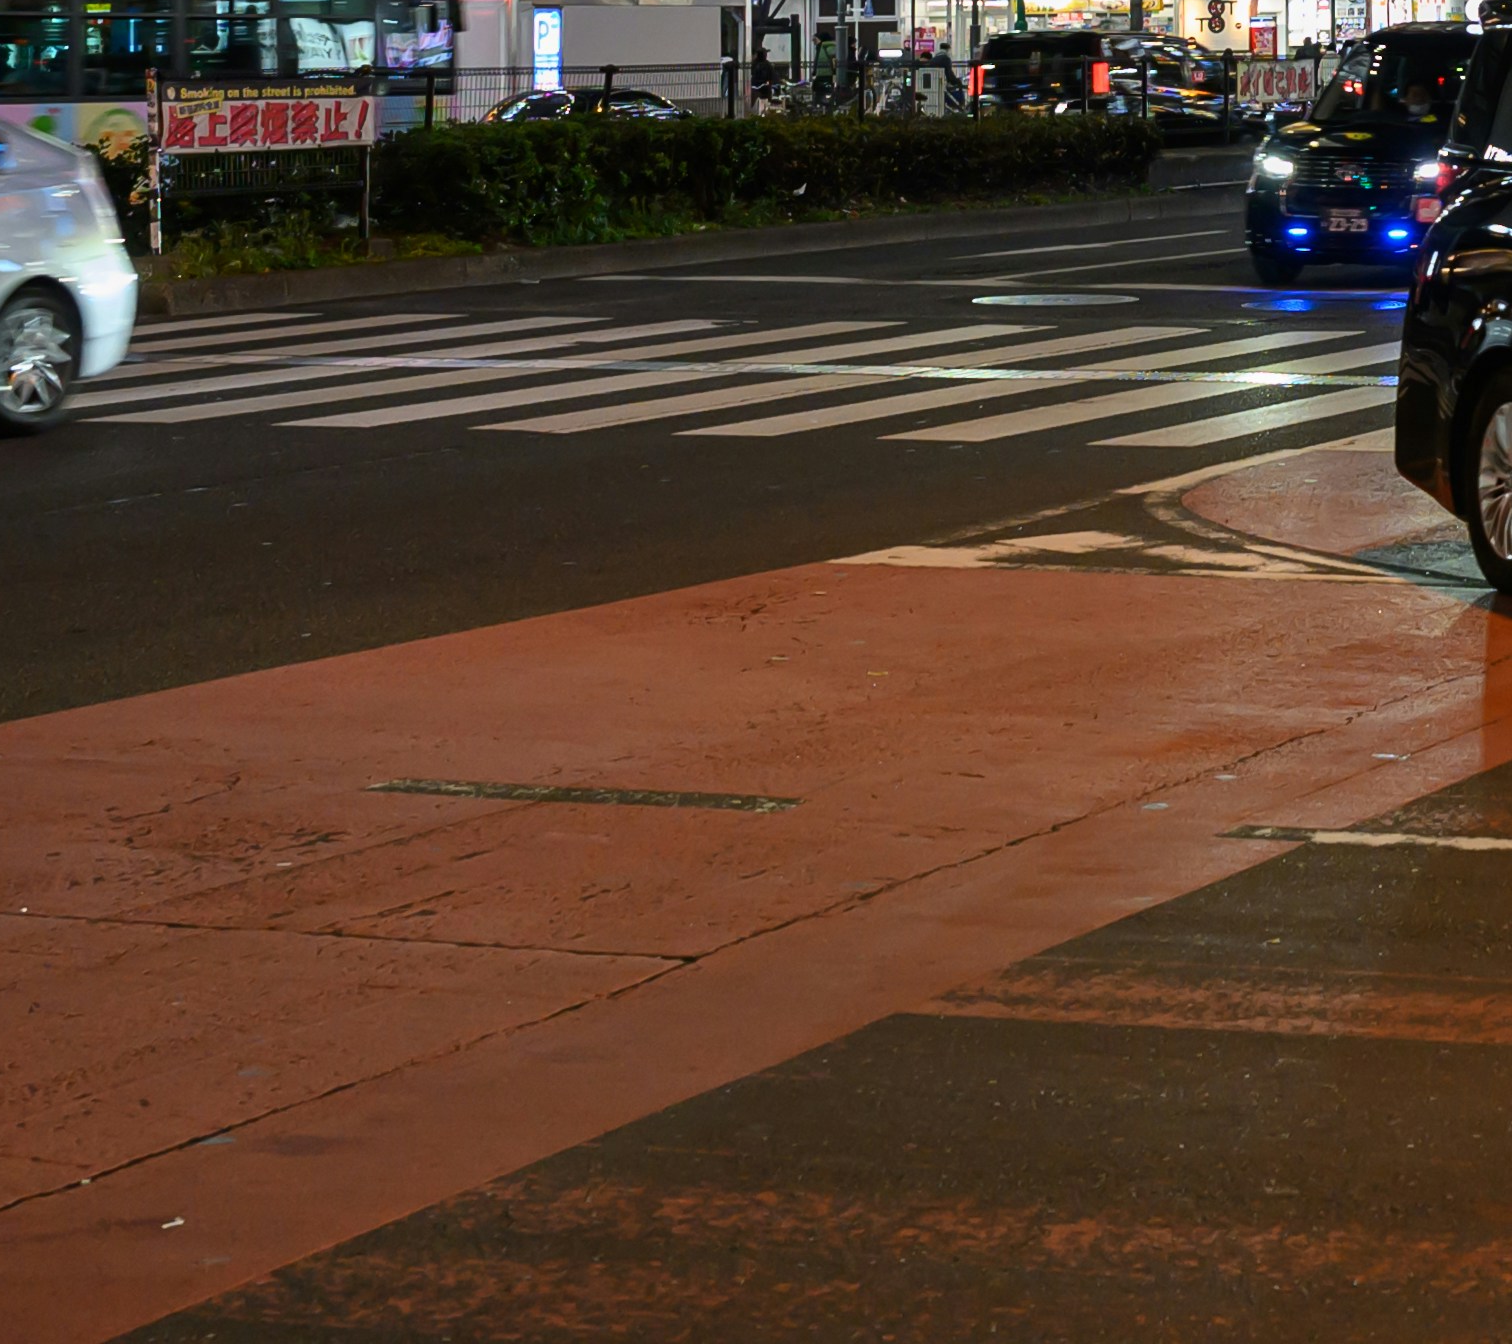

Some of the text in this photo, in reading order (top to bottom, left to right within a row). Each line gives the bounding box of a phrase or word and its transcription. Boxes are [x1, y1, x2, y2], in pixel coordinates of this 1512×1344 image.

[180, 87, 225, 100] Smoking
[227, 89, 239, 99] on
[293, 87, 302, 97] is
